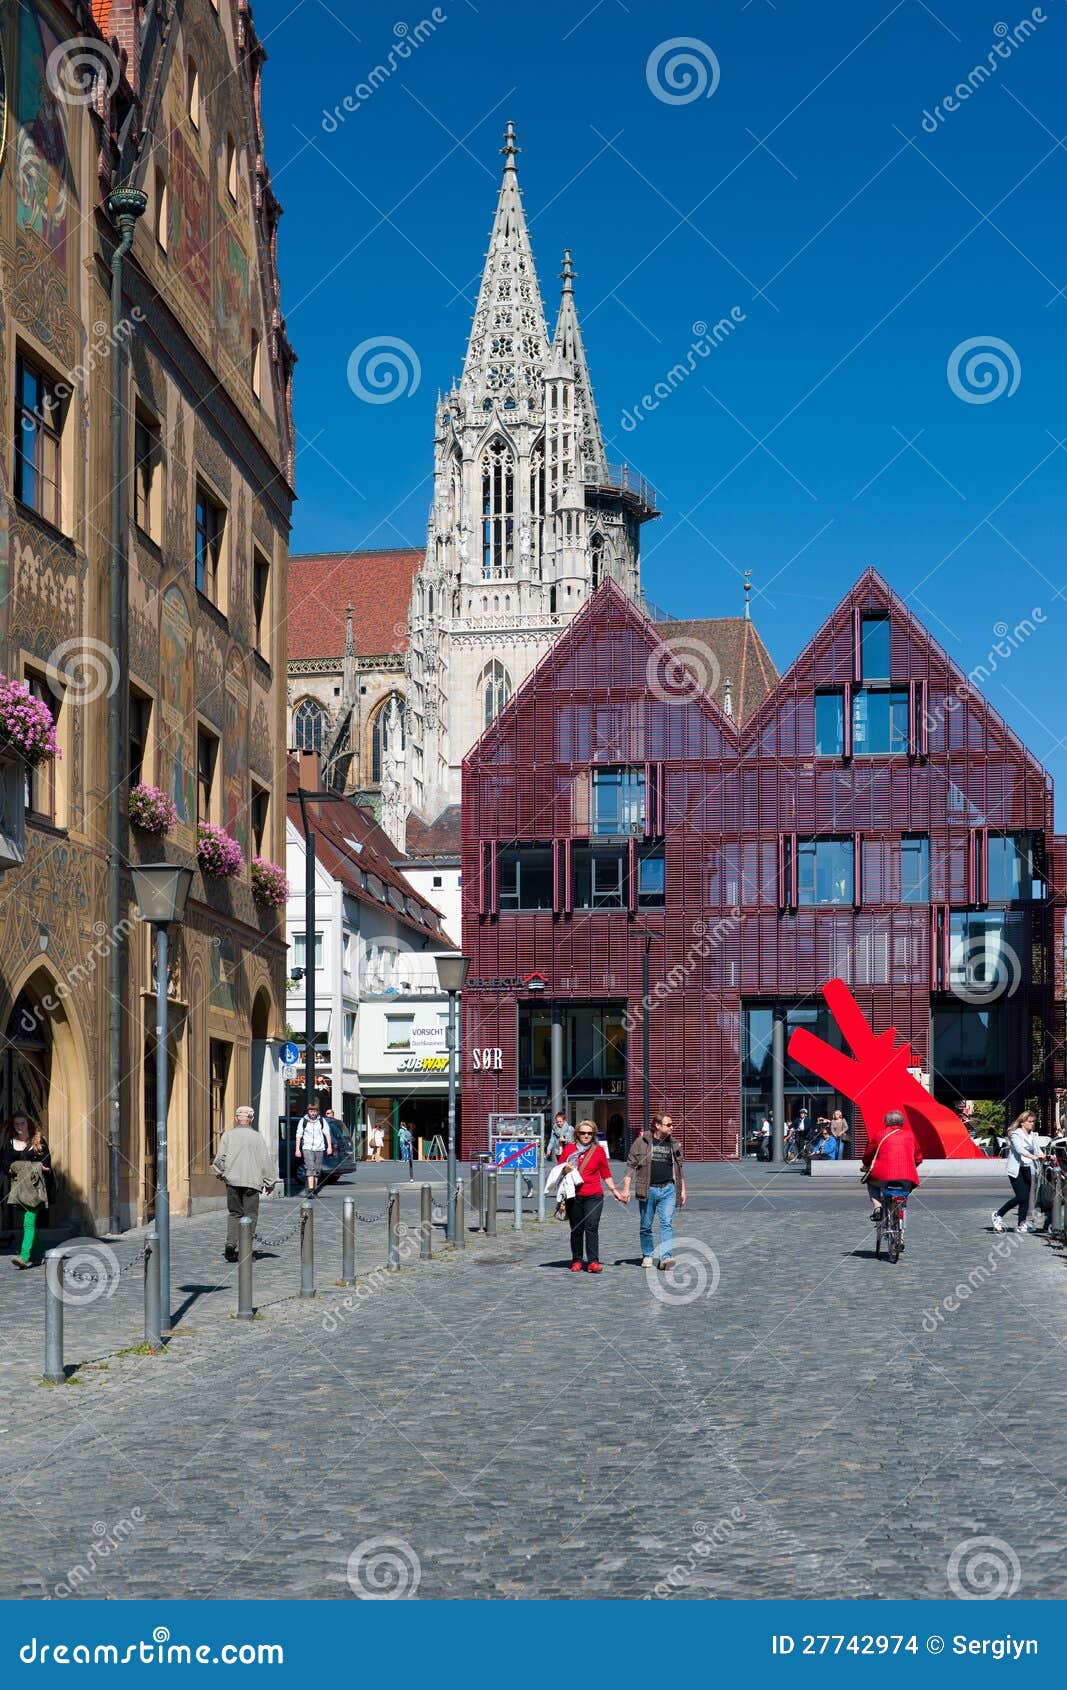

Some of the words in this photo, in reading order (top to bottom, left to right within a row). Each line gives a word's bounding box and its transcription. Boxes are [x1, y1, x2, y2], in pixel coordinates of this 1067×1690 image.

[412, 1028, 444, 1037] VORSICHT
[397, 1057, 450, 1073] SUBWAY
[473, 1048, 503, 1070] SØR
